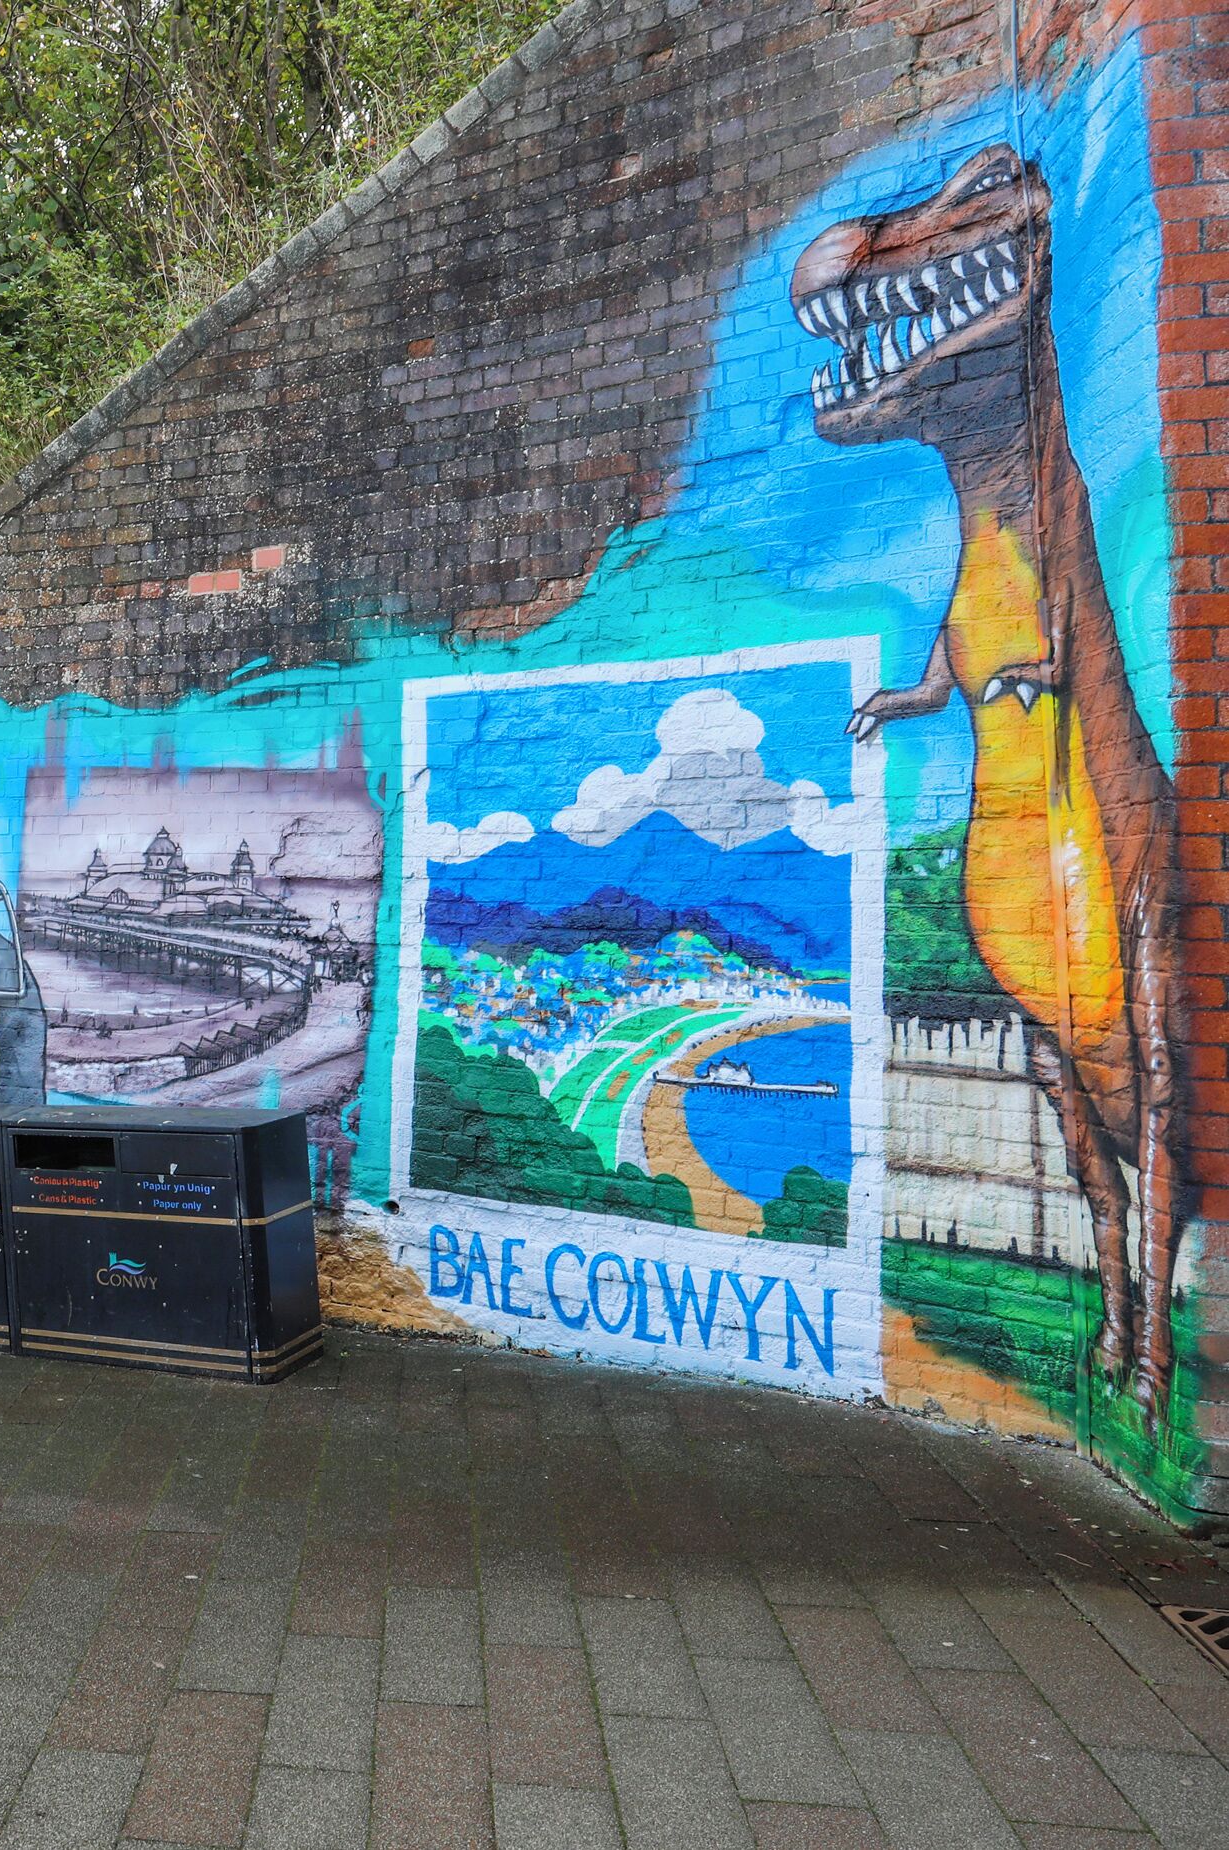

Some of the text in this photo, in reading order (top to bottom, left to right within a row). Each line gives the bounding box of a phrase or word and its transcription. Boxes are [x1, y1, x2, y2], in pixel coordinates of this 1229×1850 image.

[142, 1181, 211, 1195] Papur yn Unig
[39, 1193, 60, 1203] Cans
[69, 1194, 97, 1205] Plastic
[153, 1199, 202, 1212] Paper only
[96, 1267, 158, 1290] CONWY
[429, 1224, 838, 1377] BAE COLWYN
